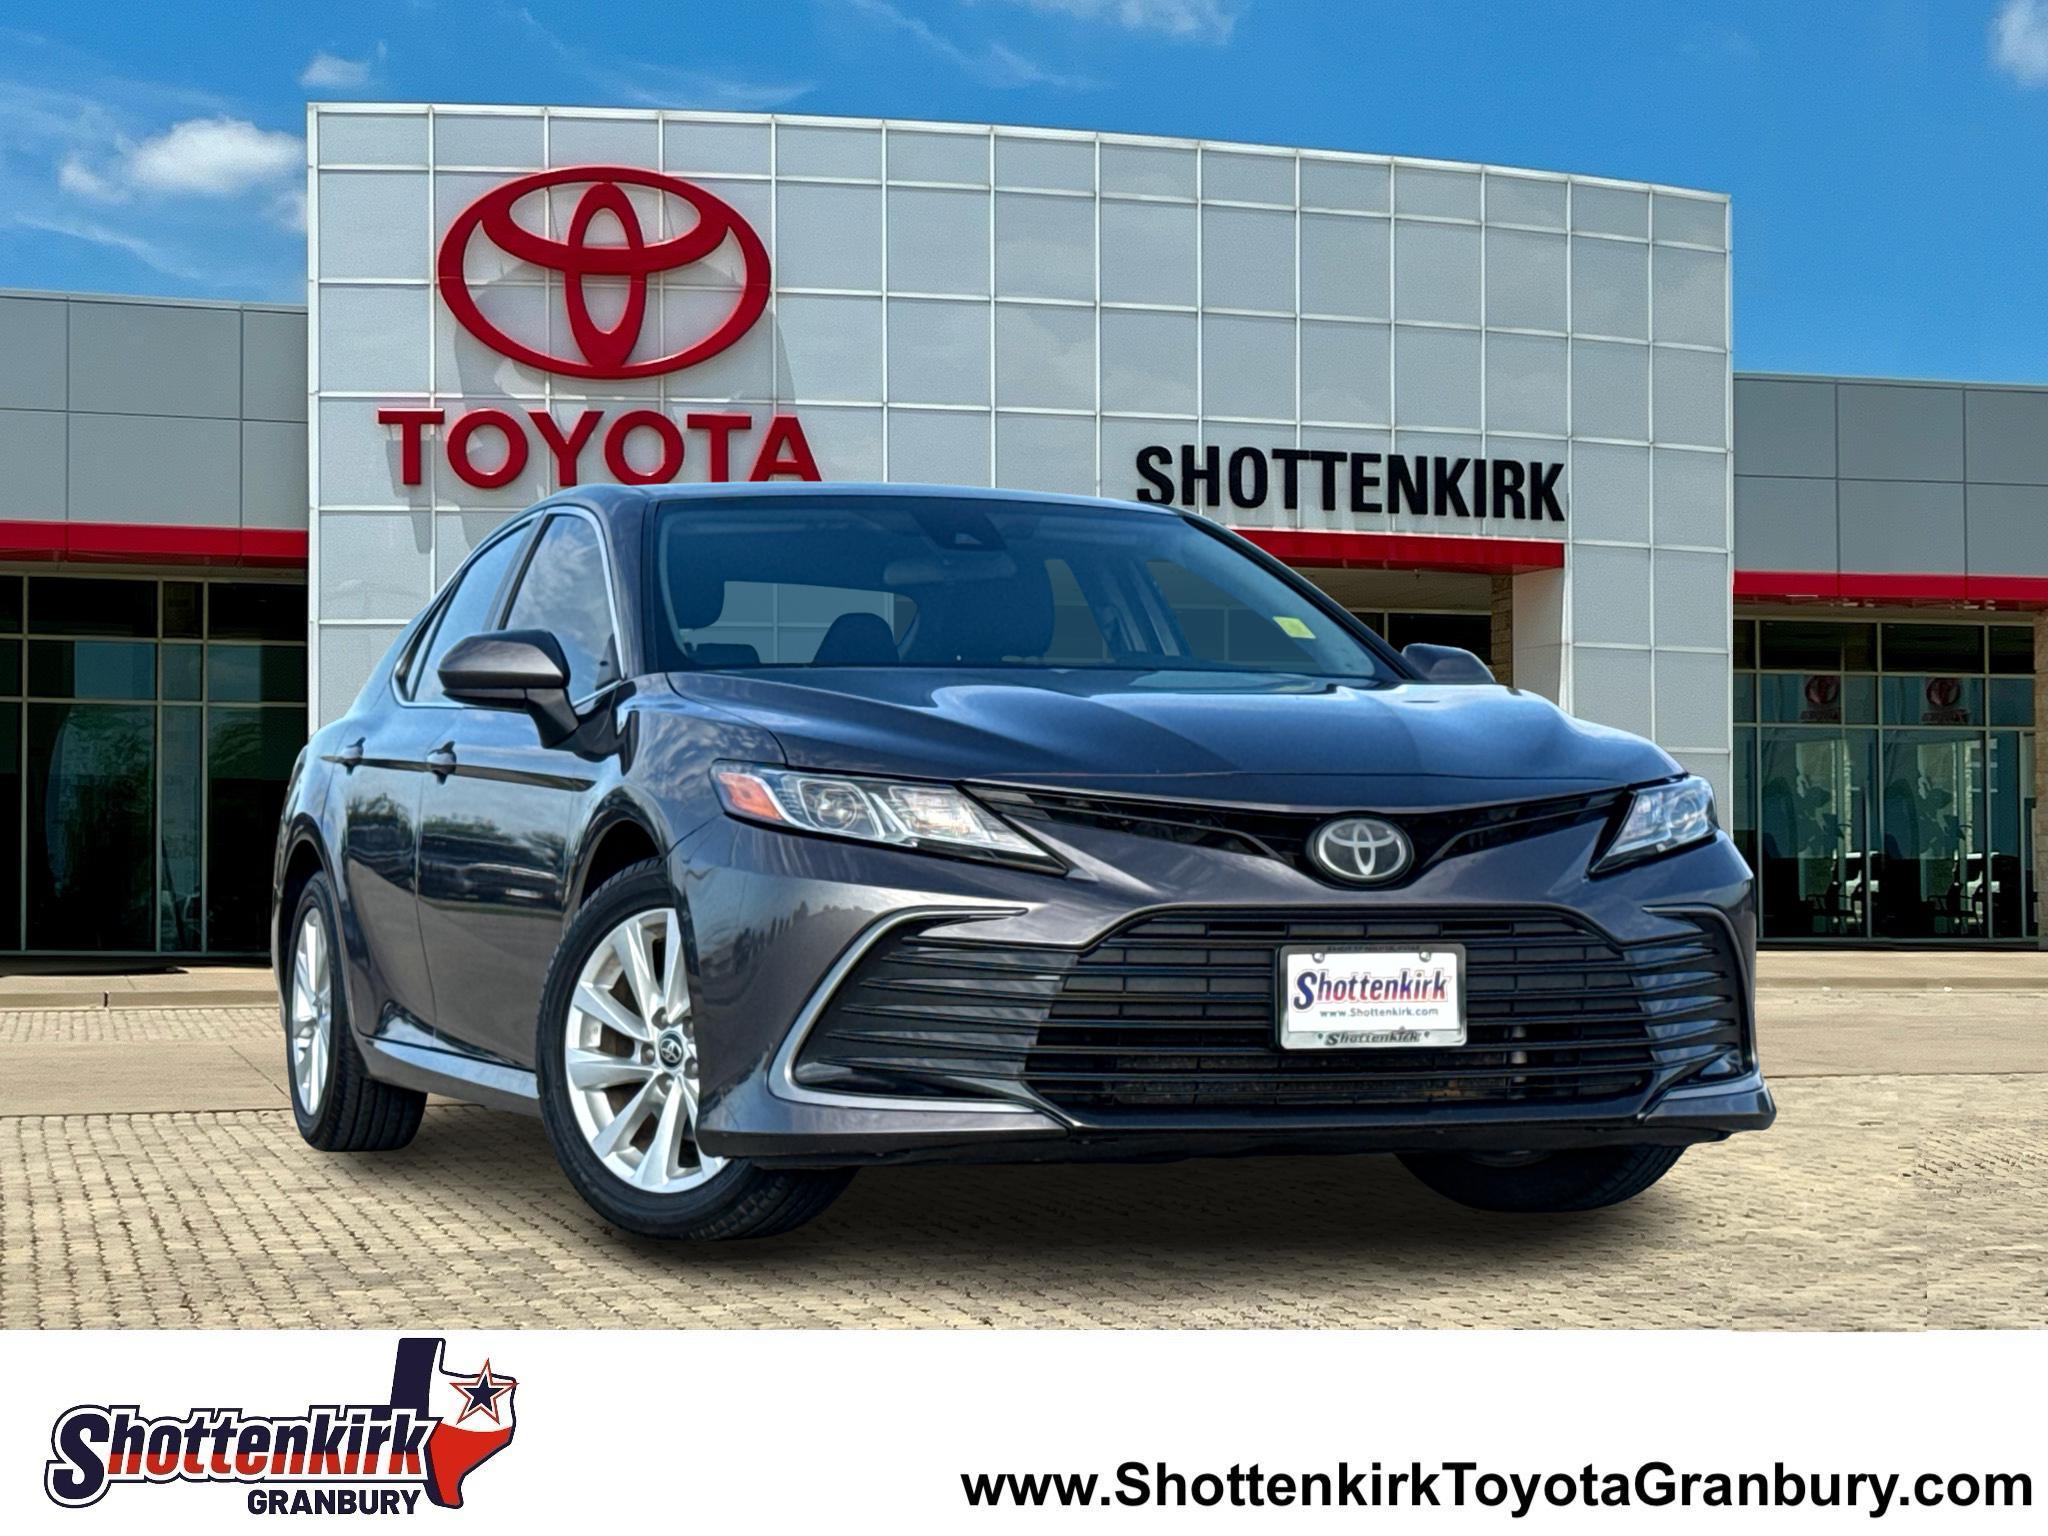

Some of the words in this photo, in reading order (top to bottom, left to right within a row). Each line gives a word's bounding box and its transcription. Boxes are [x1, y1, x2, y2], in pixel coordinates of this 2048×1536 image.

[378, 407, 823, 488] TOYOTA
[1136, 444, 1565, 522] SHOTTENKIRK
[1293, 970, 1448, 1010] Shottenkirk
[1320, 1007, 1439, 1017] www.Shottenkirk.com
